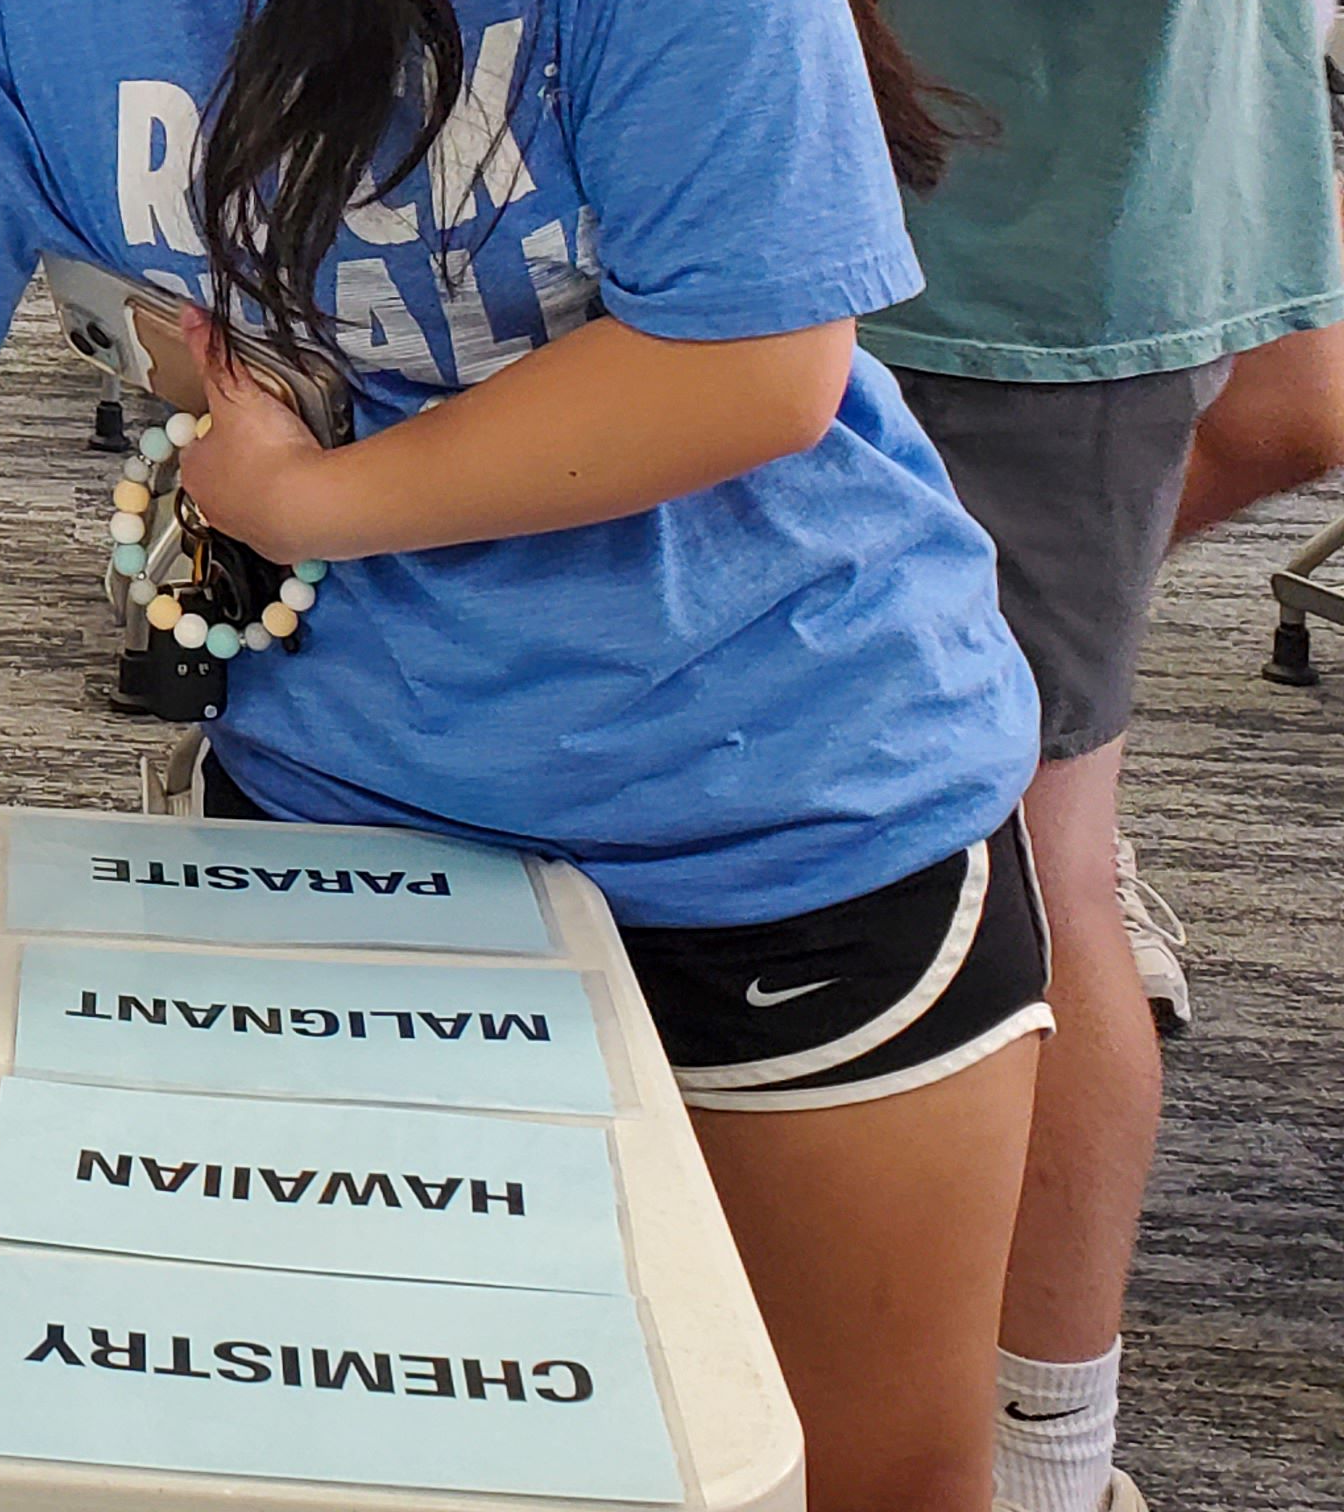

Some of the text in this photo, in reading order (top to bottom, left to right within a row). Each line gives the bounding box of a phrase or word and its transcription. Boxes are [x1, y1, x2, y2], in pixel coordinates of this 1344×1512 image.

[91, 857, 452, 897] PARASITE
[65, 990, 551, 1042] MALIGNANT
[76, 1149, 526, 1216] HAWAIIAN
[23, 1323, 594, 1403] CHEMISTRY
